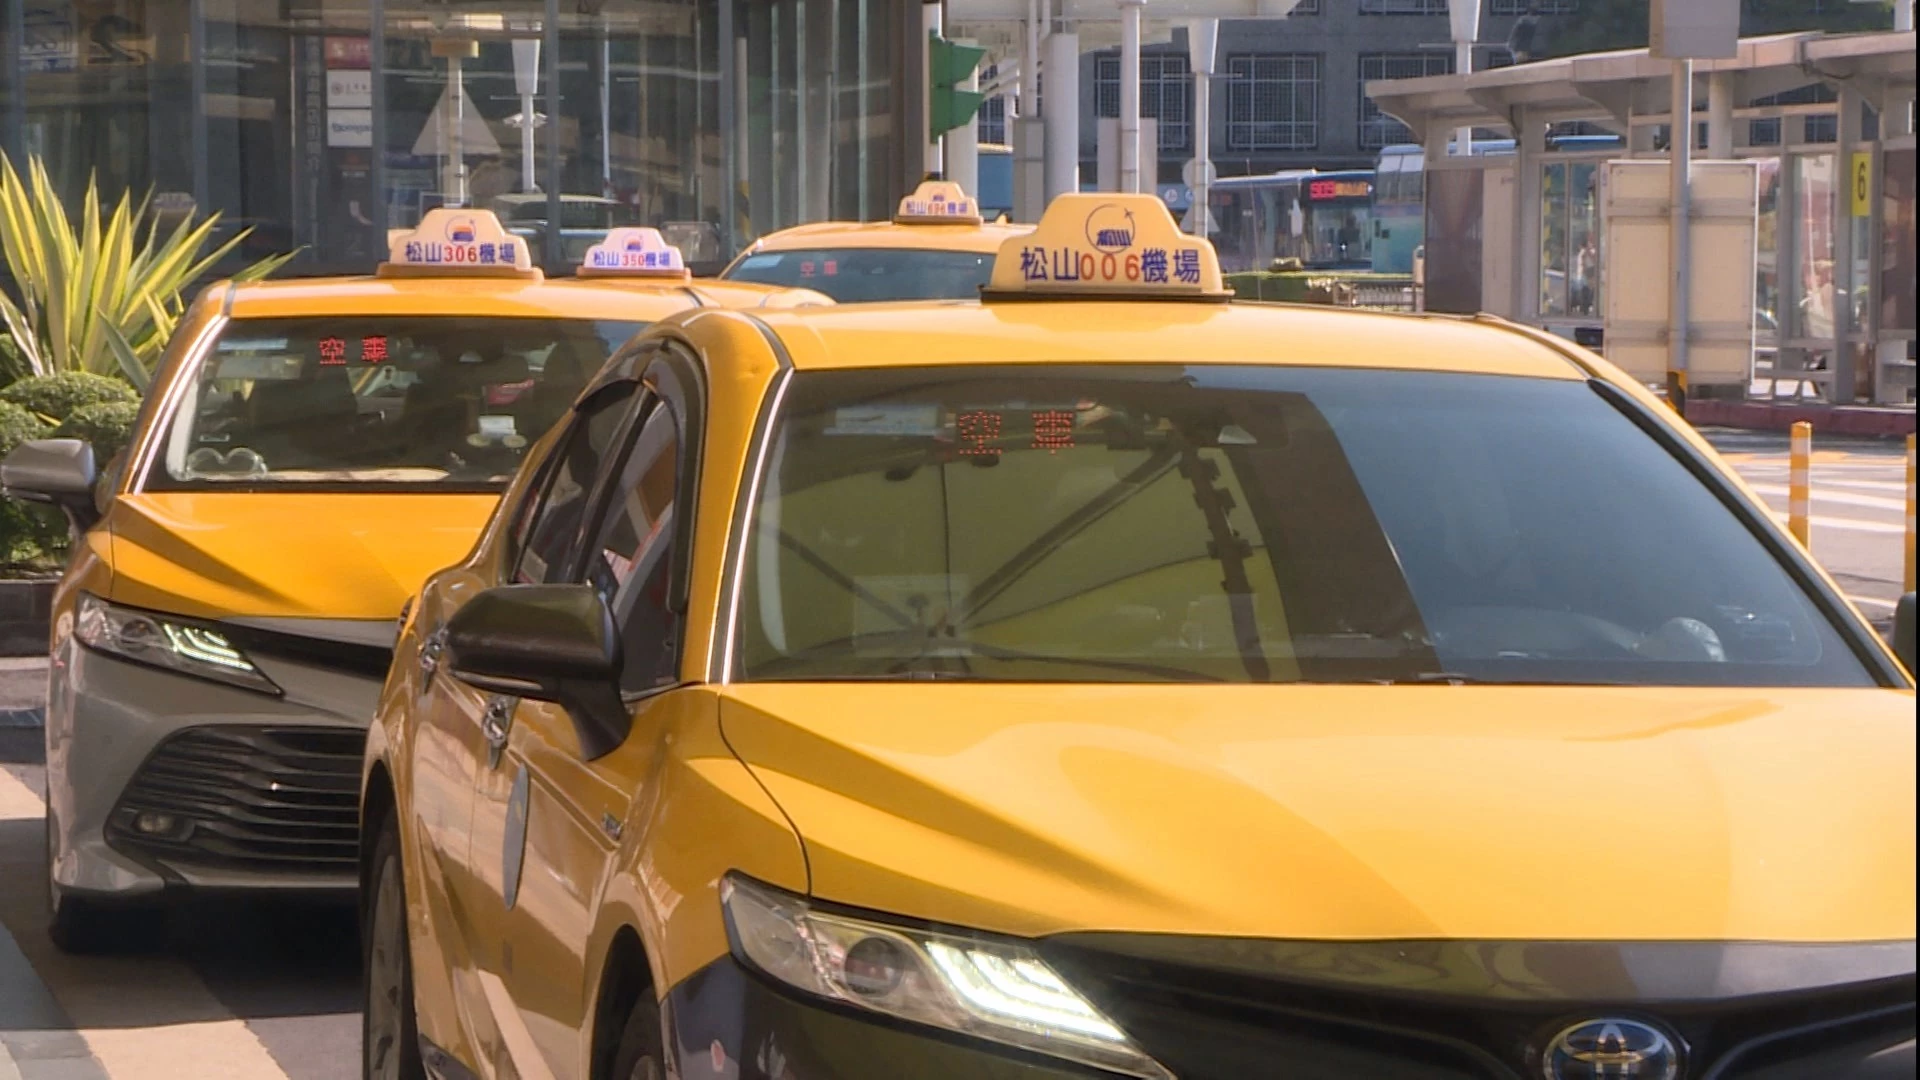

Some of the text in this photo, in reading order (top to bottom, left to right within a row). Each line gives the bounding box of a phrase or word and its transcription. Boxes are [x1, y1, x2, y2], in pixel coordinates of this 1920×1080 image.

[1857, 161, 1867, 202] 6
[405, 241, 516, 265] 松山306機場
[593, 251, 671, 268] 松山350機場
[1020, 246, 1201, 284] 松山006機場
[319, 334, 390, 365] 空車
[959, 410, 1076, 455] 空車
